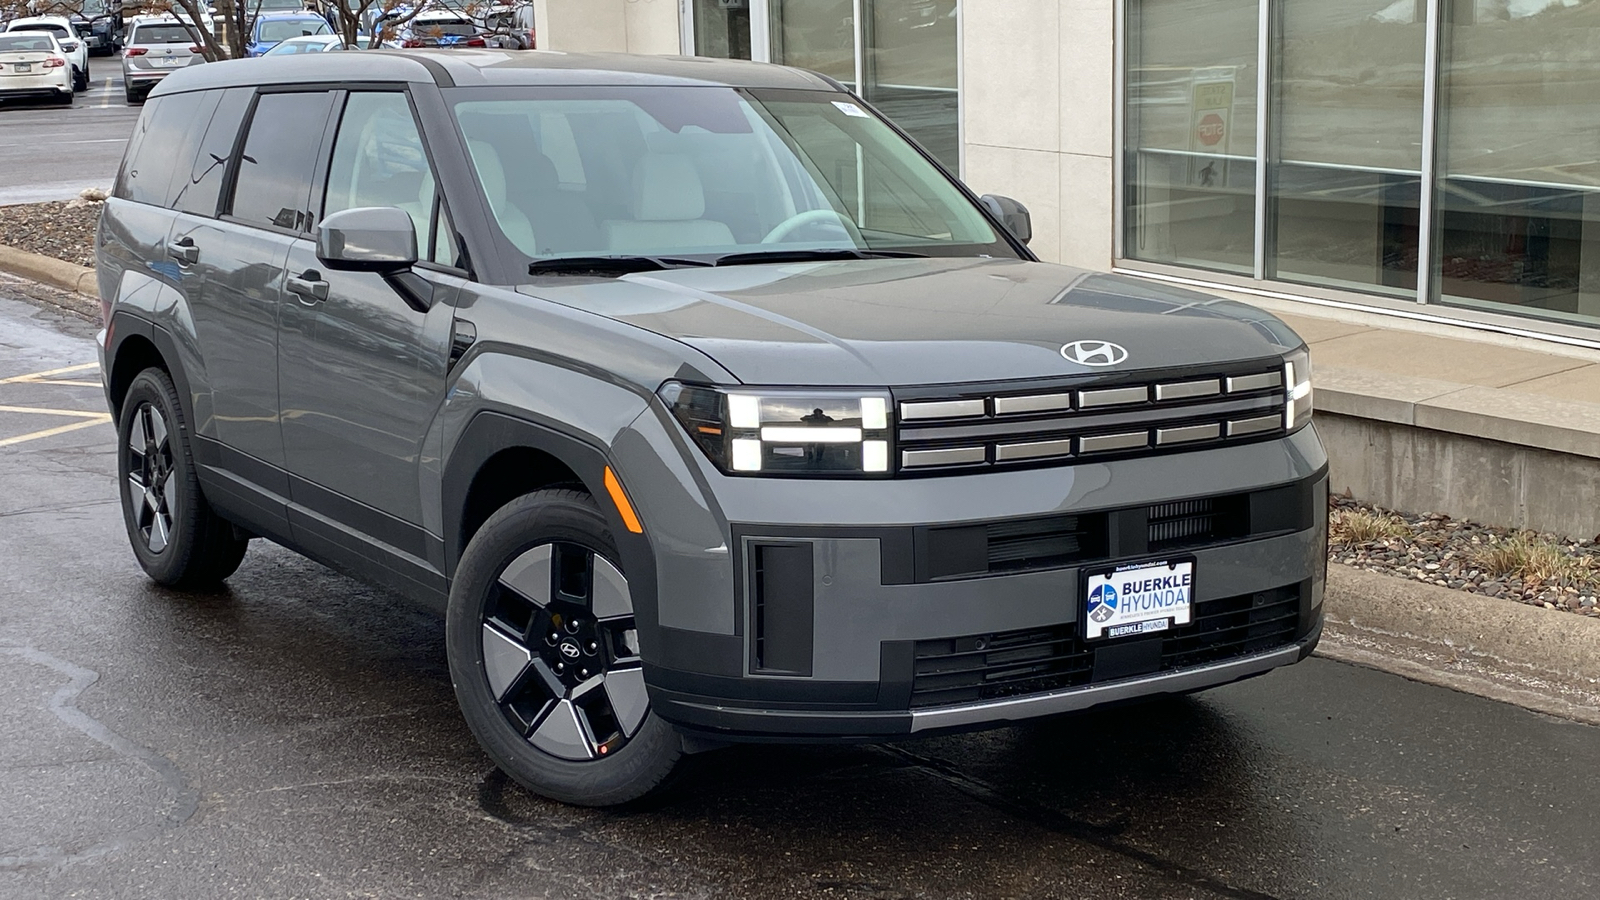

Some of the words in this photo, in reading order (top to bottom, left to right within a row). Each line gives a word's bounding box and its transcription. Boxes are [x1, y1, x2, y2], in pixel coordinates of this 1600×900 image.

[1115, 560, 1168, 571] buerklehyundai.com
[1122, 573, 1191, 596] BUERKLE
[1120, 587, 1191, 614] HYUNDAI
[1109, 624, 1142, 637] BUERKLE
[1143, 620, 1168, 631] HYUNDAI
